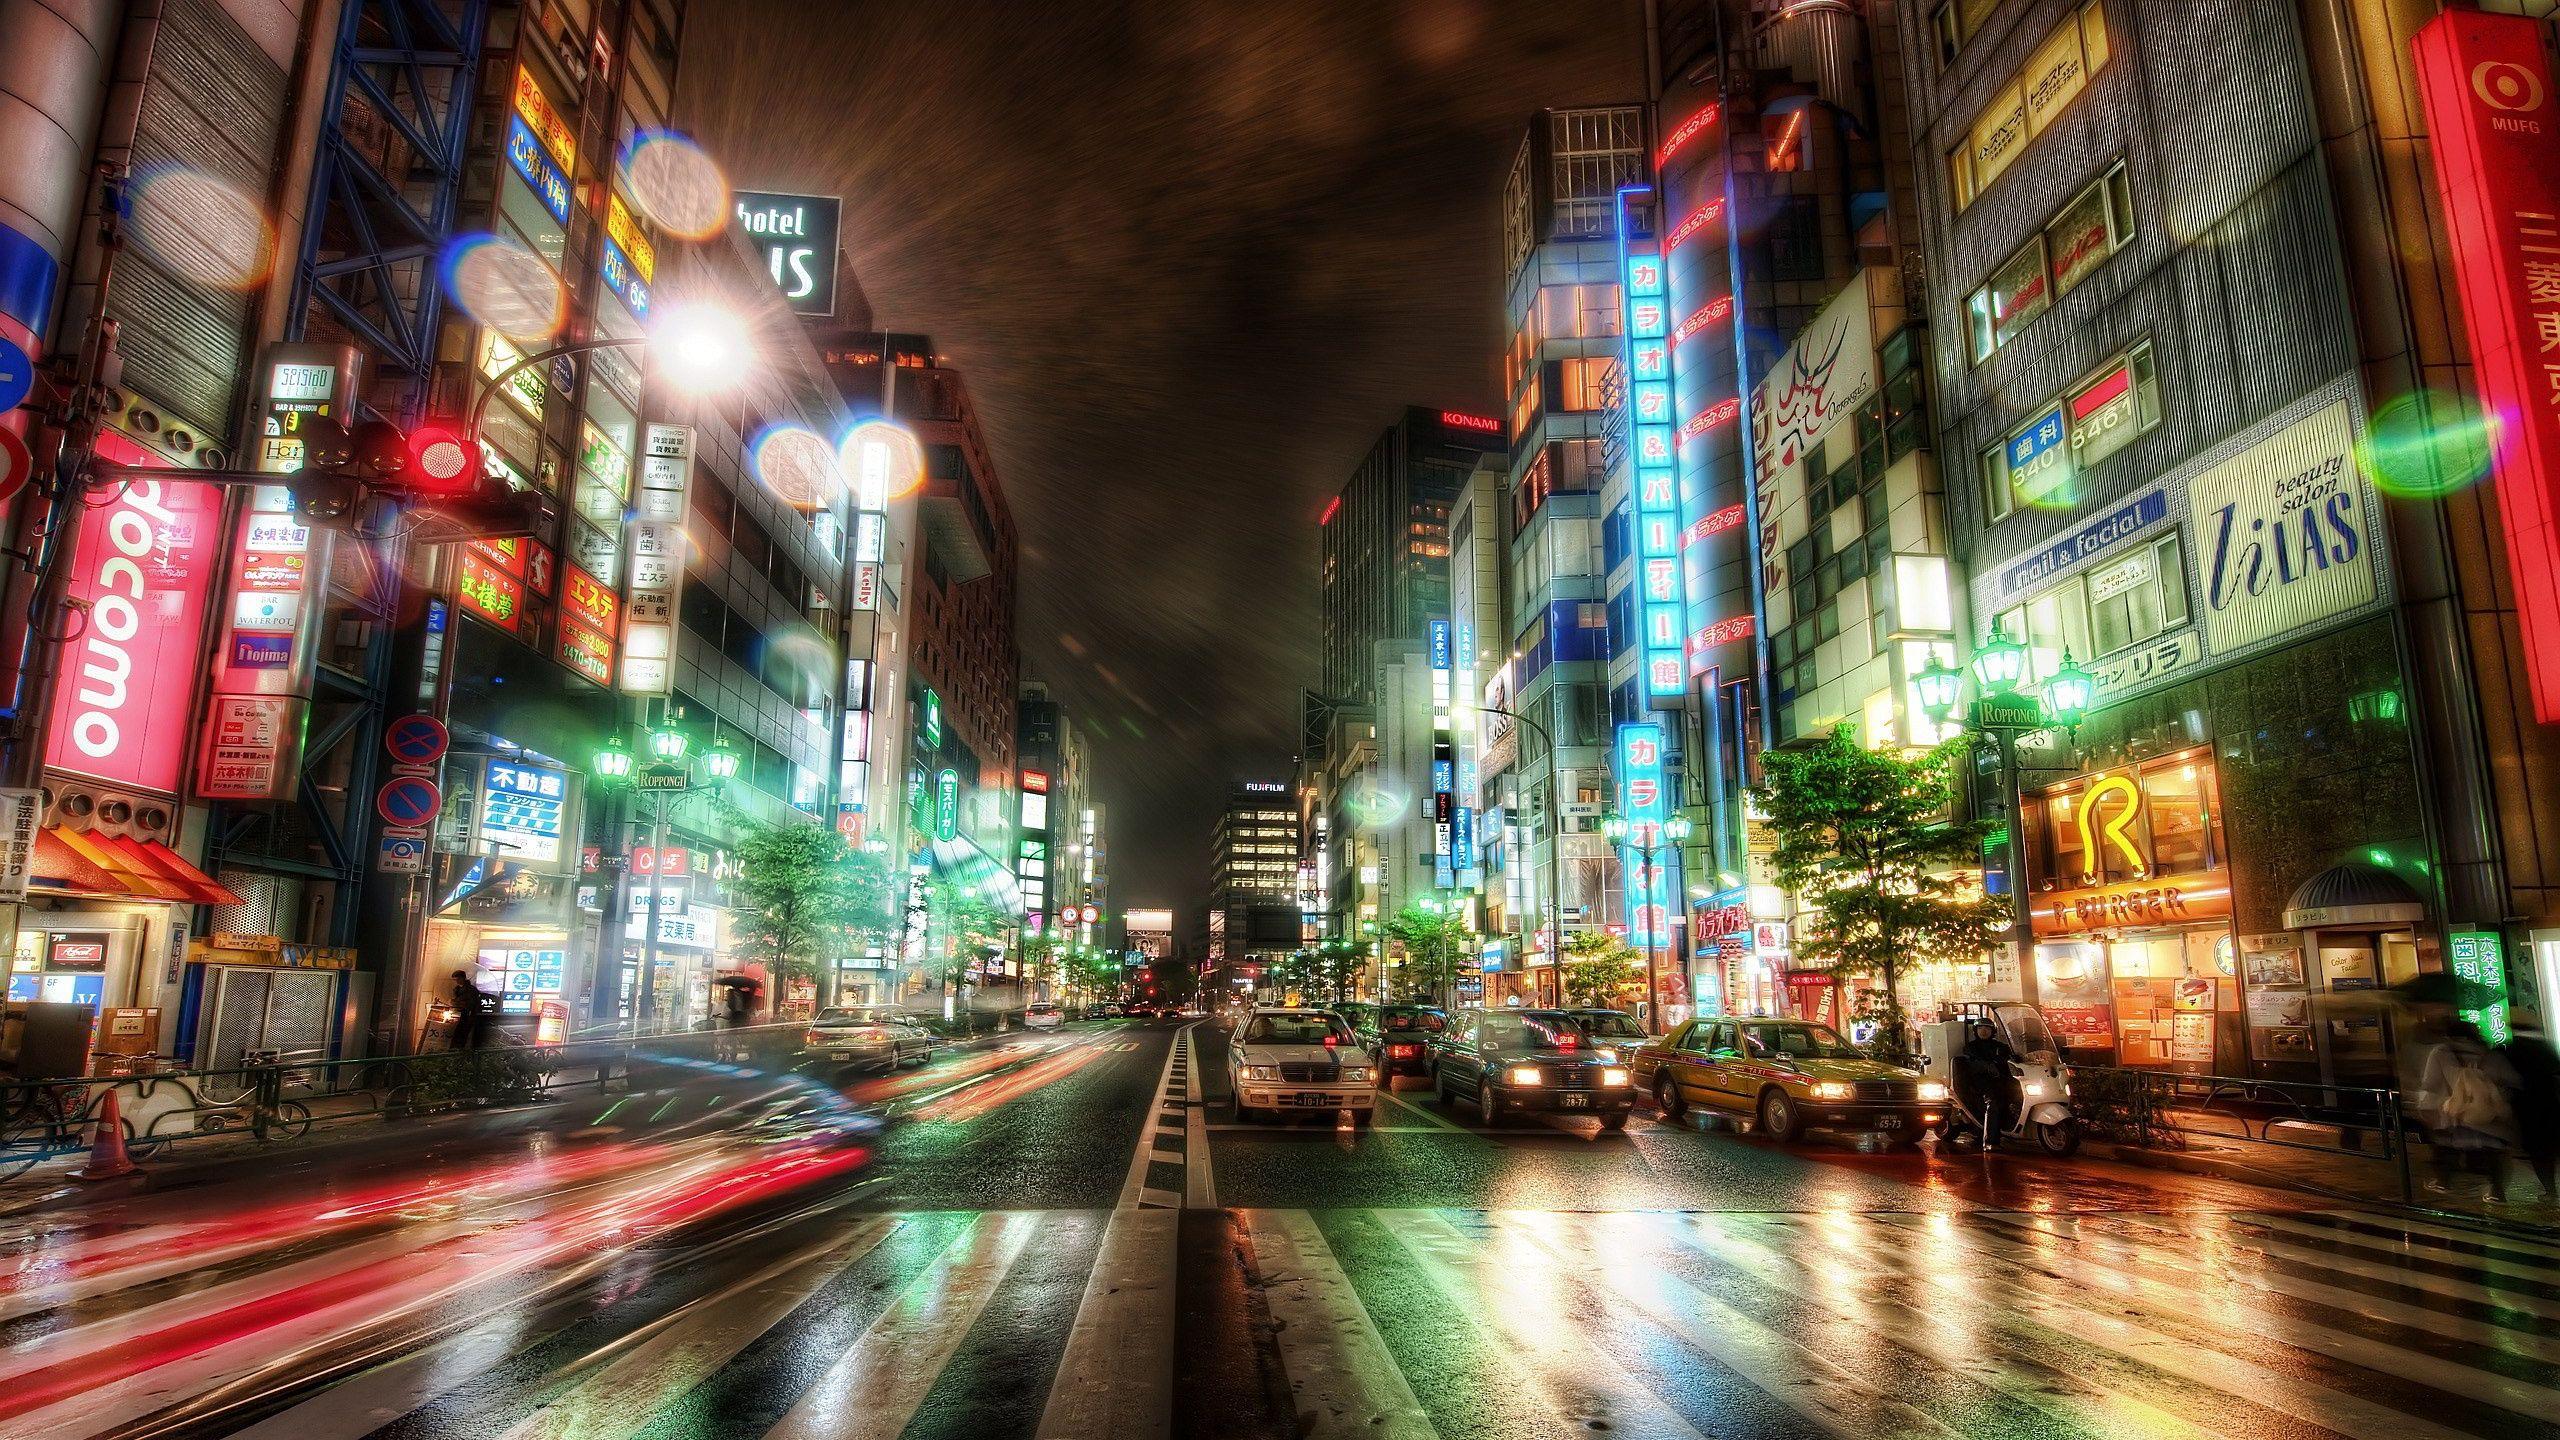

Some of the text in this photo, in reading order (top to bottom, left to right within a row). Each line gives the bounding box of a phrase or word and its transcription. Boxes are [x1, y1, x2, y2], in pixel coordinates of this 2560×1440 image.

[2492, 116, 2540, 134] MUFG
[511, 132, 567, 215] 心療内科
[1671, 204, 1720, 249] カラオケ
[604, 249, 627, 294] 内科
[268, 422, 278, 433] 7F
[1442, 411, 1498, 431] KONAMI
[1681, 404, 1734, 444] カラオケ
[2016, 417, 2058, 463] 歯科
[1751, 381, 1784, 597] オリエンタル
[2275, 453, 2344, 499] beauty
[2281, 476, 2339, 515] salon
[154, 526, 173, 570] NTT
[474, 541, 507, 565] CHINESE
[2015, 552, 2057, 588] nail
[2058, 550, 2072, 566] &
[2077, 504, 2143, 557] facial
[638, 573, 668, 582] エステ
[643, 562, 666, 571] 中国
[570, 574, 614, 618] エステ
[637, 594, 667, 604] 不動産
[858, 567, 873, 605] Kelly
[72, 480, 177, 758] docomo
[2133, 642, 2182, 679] リラ
[1983, 702, 2038, 724] ROPPONGI
[492, 766, 561, 797] 不動産
[640, 771, 685, 789] ROPPONGI
[1246, 783, 1285, 792] FUJIFILM
[506, 794, 546, 808] マンション
[943, 783, 953, 836] モスバーガー
[10, 795, 36, 876] 違法駐車取締り
[1628, 738, 1666, 933] カラオケ館
[2077, 775, 2150, 883] R
[634, 895, 676, 906] DRGS
[2075, 887, 2188, 921] BURGER
[2296, 912, 2328, 922] リラビル
[51, 934, 67, 942] 7F
[1697, 903, 1749, 940] カラオケ館
[2330, 956, 2348, 967] Color
[2451, 937, 2481, 984] 歯科
[47, 978, 59, 987] 5F
[1749, 1066, 1767, 1077] TAXI
[1566, 1098, 1588, 1107] 28-77
[1879, 1120, 1901, 1129] 65-73
